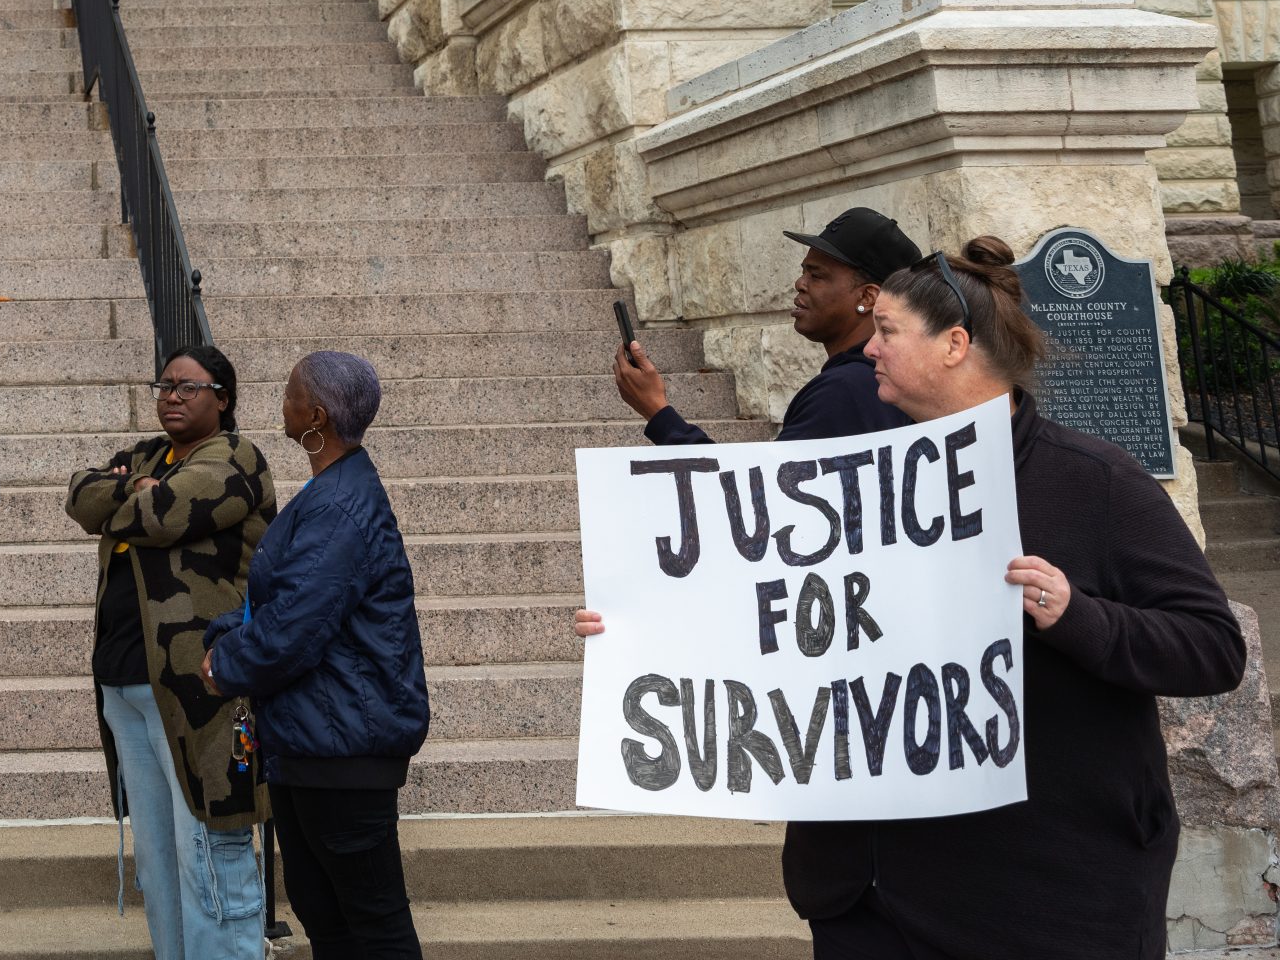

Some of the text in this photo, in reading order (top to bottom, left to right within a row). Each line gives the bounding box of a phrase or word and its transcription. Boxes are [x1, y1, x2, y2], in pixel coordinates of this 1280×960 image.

[1063, 264, 1090, 272] TEXAS
[1031, 302, 1128, 312] McLENNAN COUNTY
[1047, 311, 1113, 321] COURTHOUSE
[1058, 329, 1091, 337] JUSTICE
[1117, 328, 1151, 336] COUNTY
[1111, 336, 1153, 344] FOUNDERS
[1069, 345, 1086, 353] GIVE
[1107, 344, 1133, 352] YOUNG
[1132, 352, 1154, 360] UNTIL
[1123, 360, 1154, 368] COUNTY
[1044, 379, 1094, 387] COURTHOUSE
[1098, 378, 1116, 386] (THE
[1119, 378, 1157, 386] COUNTY'S
[1094, 387, 1122, 395] DURING
[1125, 386, 1144, 394] PEAK
[1145, 394, 1159, 402] THE
[1077, 403, 1110, 411] REVIVAL
[1149, 402, 1159, 410] BY
[1057, 411, 1091, 419] GORDON
[1141, 410, 1161, 418] USES
[1099, 419, 1142, 427] CONCRETE,
[1145, 434, 1163, 442] HERE
[629, 421, 984, 579] JUSTICE
[755, 571, 883, 658] FOR
[621, 638, 1020, 795] SURVIVORS
